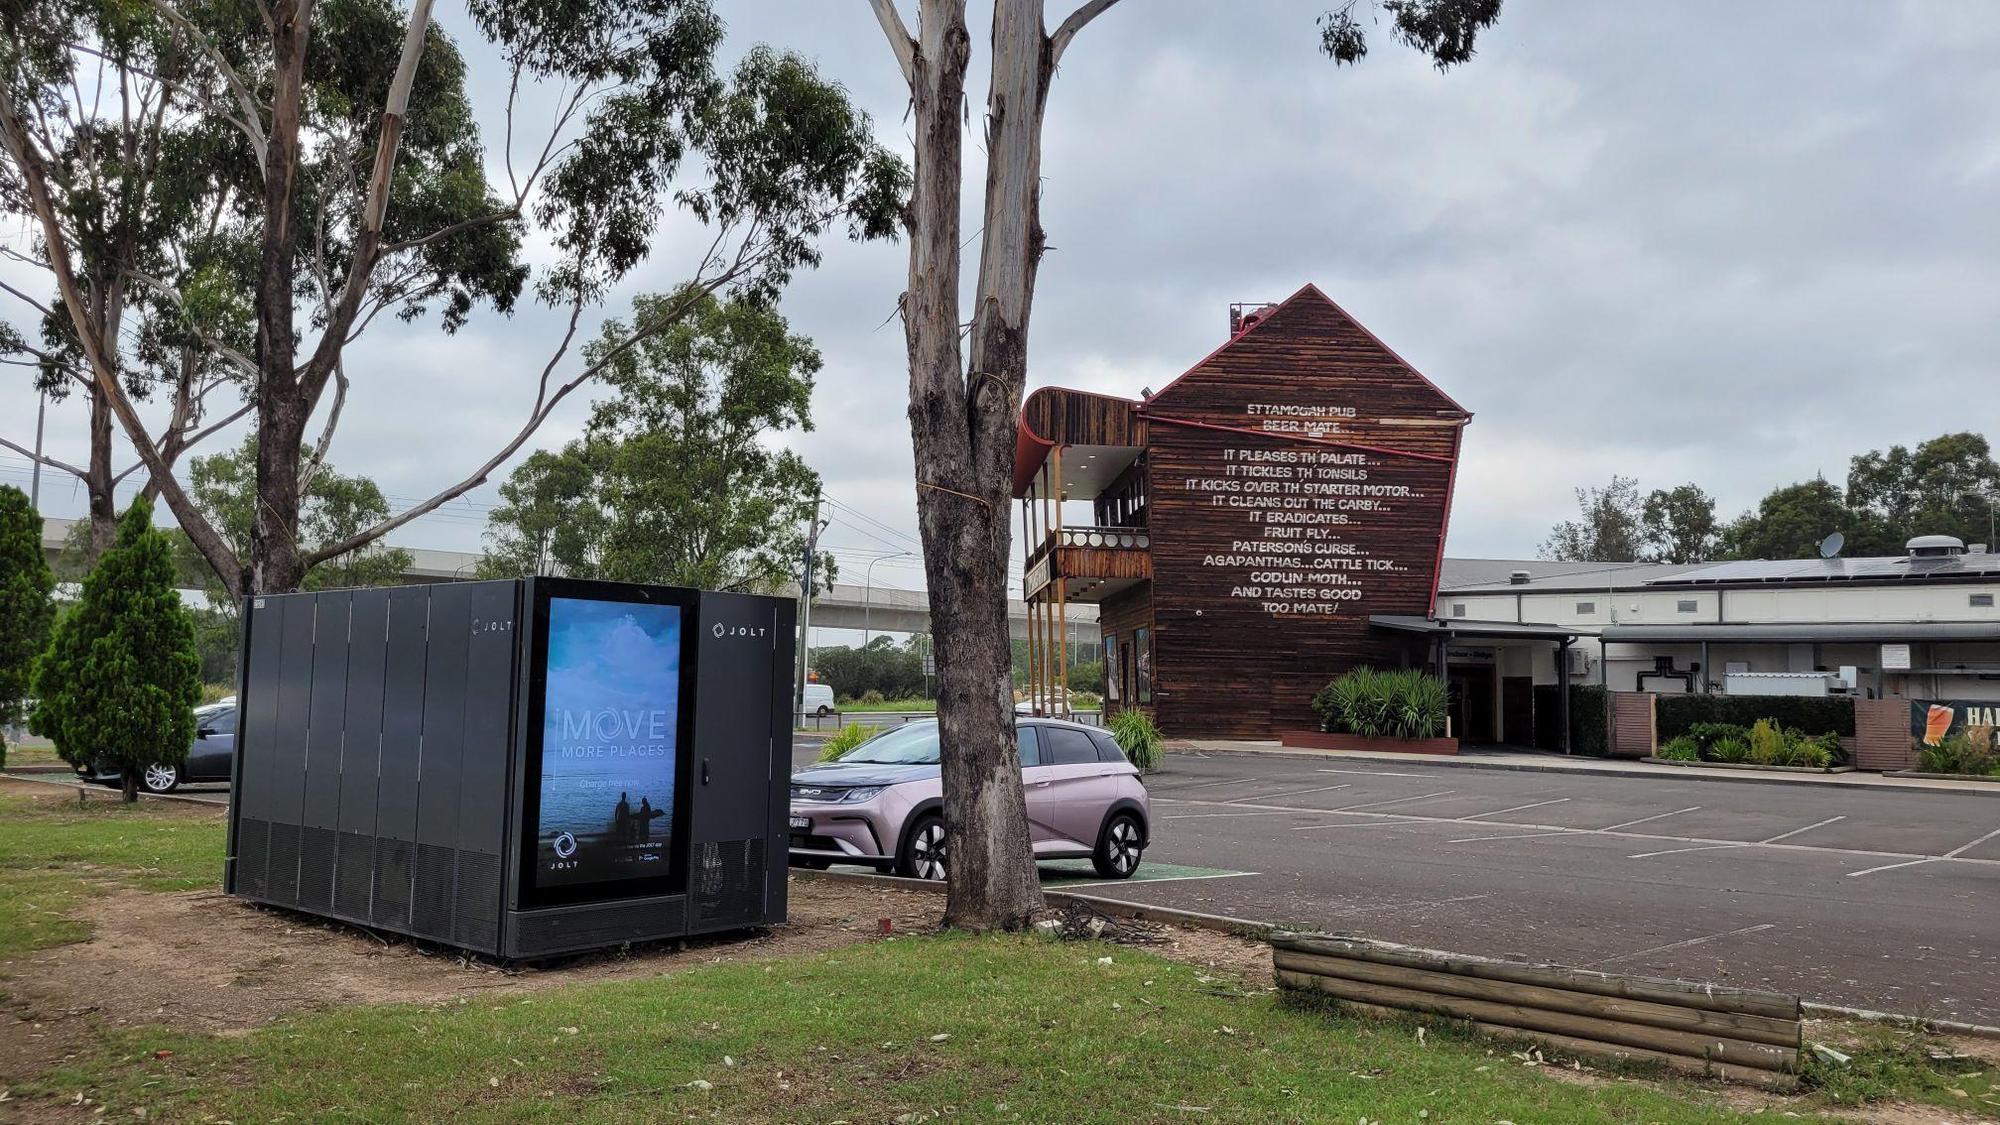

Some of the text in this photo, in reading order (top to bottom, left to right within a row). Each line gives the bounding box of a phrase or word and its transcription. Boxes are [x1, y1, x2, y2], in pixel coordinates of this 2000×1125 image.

[1247, 404, 1356, 418] ETTAMOGAH PUB
[1263, 420, 1299, 432] BEER
[1224, 449, 1235, 460] IT
[1239, 450, 1297, 463] PLEASES
[1318, 453, 1381, 466] PALATE...
[1226, 465, 1238, 476] IT
[1240, 465, 1292, 478] TICKLES
[1317, 468, 1368, 480] TONSILS
[1186, 479, 1198, 490] IT
[1201, 479, 1241, 492] KICKS
[1243, 481, 1280, 493] OVER
[1304, 483, 1361, 496] STARTER
[1363, 485, 1425, 498] MOTOR...
[1212, 495, 1391, 511] IT CLEANS OUT THE CARBY...
[1249, 511, 1361, 525] IT ERADICATES...
[1264, 527, 1341, 539] FRUIT FLY...
[1232, 540, 1370, 555] PATERSON'S CURSE...
[1365, 560, 1408, 571] TICK...
[1308, 573, 1362, 586] MOTH...
[1231, 586, 1362, 600] AND TASTES GOOD
[1262, 602, 1339, 614] TOO MATE!
[484, 621, 512, 631] JOLT
[729, 626, 766, 637] JOLT
[1966, 707, 2000, 726] HA
[562, 707, 666, 743] MOVE
[561, 745, 665, 758] MORE PLACES
[580, 779, 607, 789] Charge
[550, 861, 579, 870] JOLT
